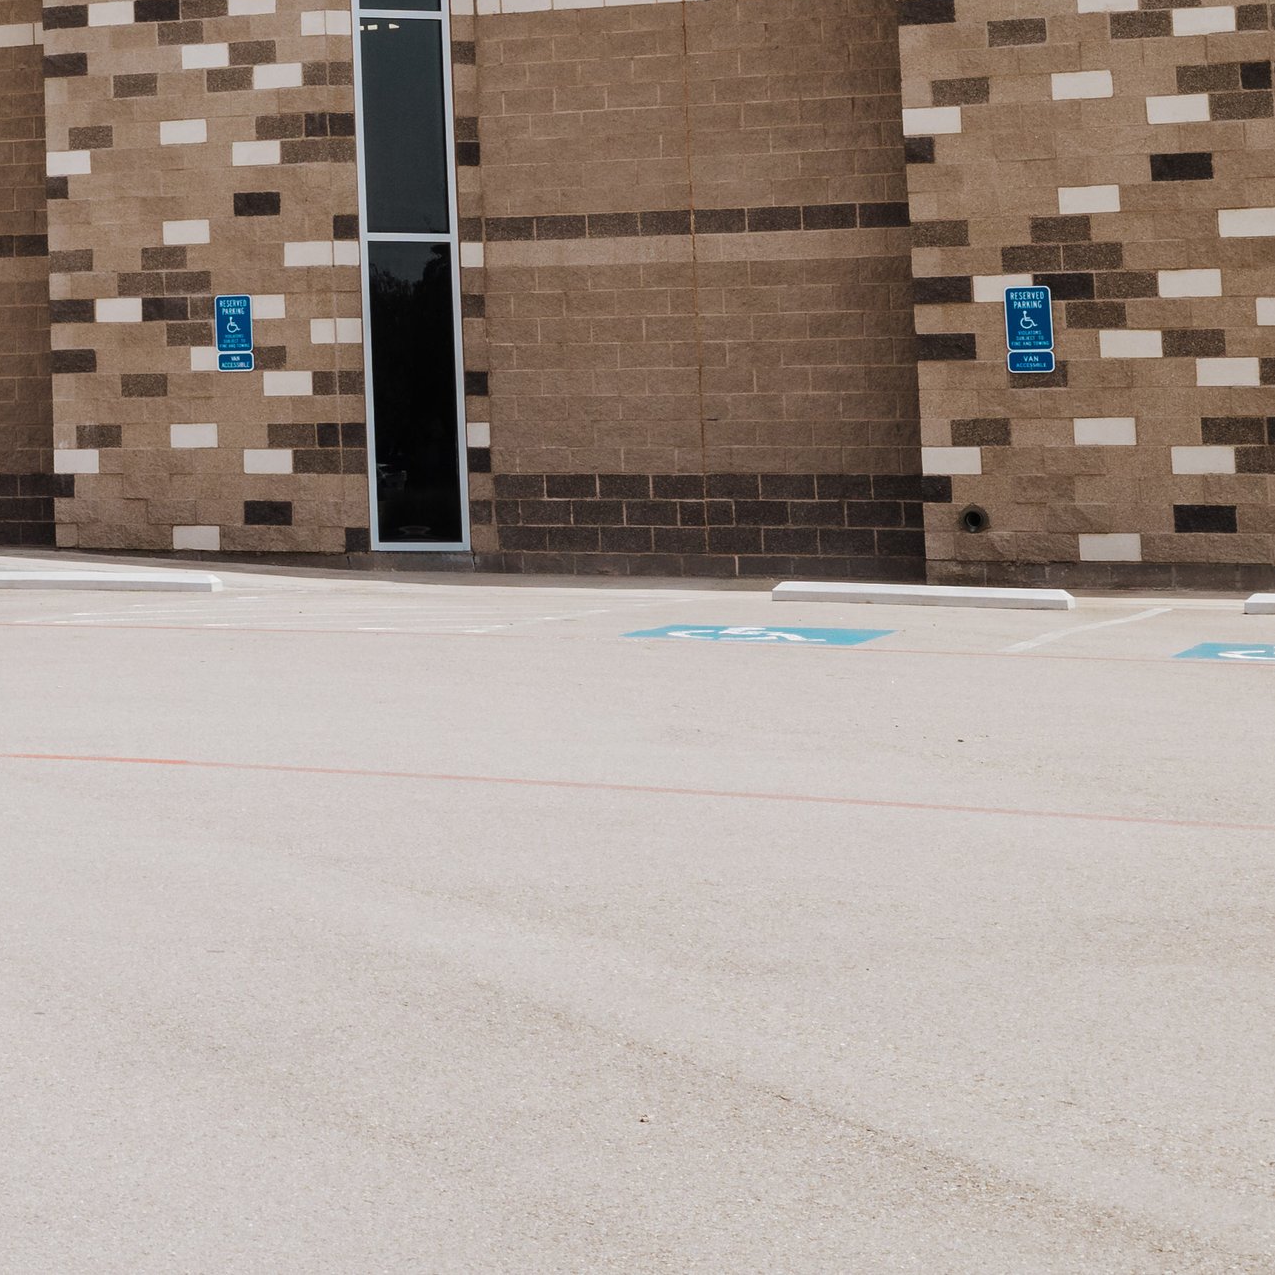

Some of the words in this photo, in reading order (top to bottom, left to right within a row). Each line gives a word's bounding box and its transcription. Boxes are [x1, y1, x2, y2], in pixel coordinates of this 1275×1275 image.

[1010, 291, 1044, 300] RESERVED
[219, 299, 247, 307] RESERVED
[1013, 300, 1043, 309] PARKING
[222, 307, 245, 315] PARKING
